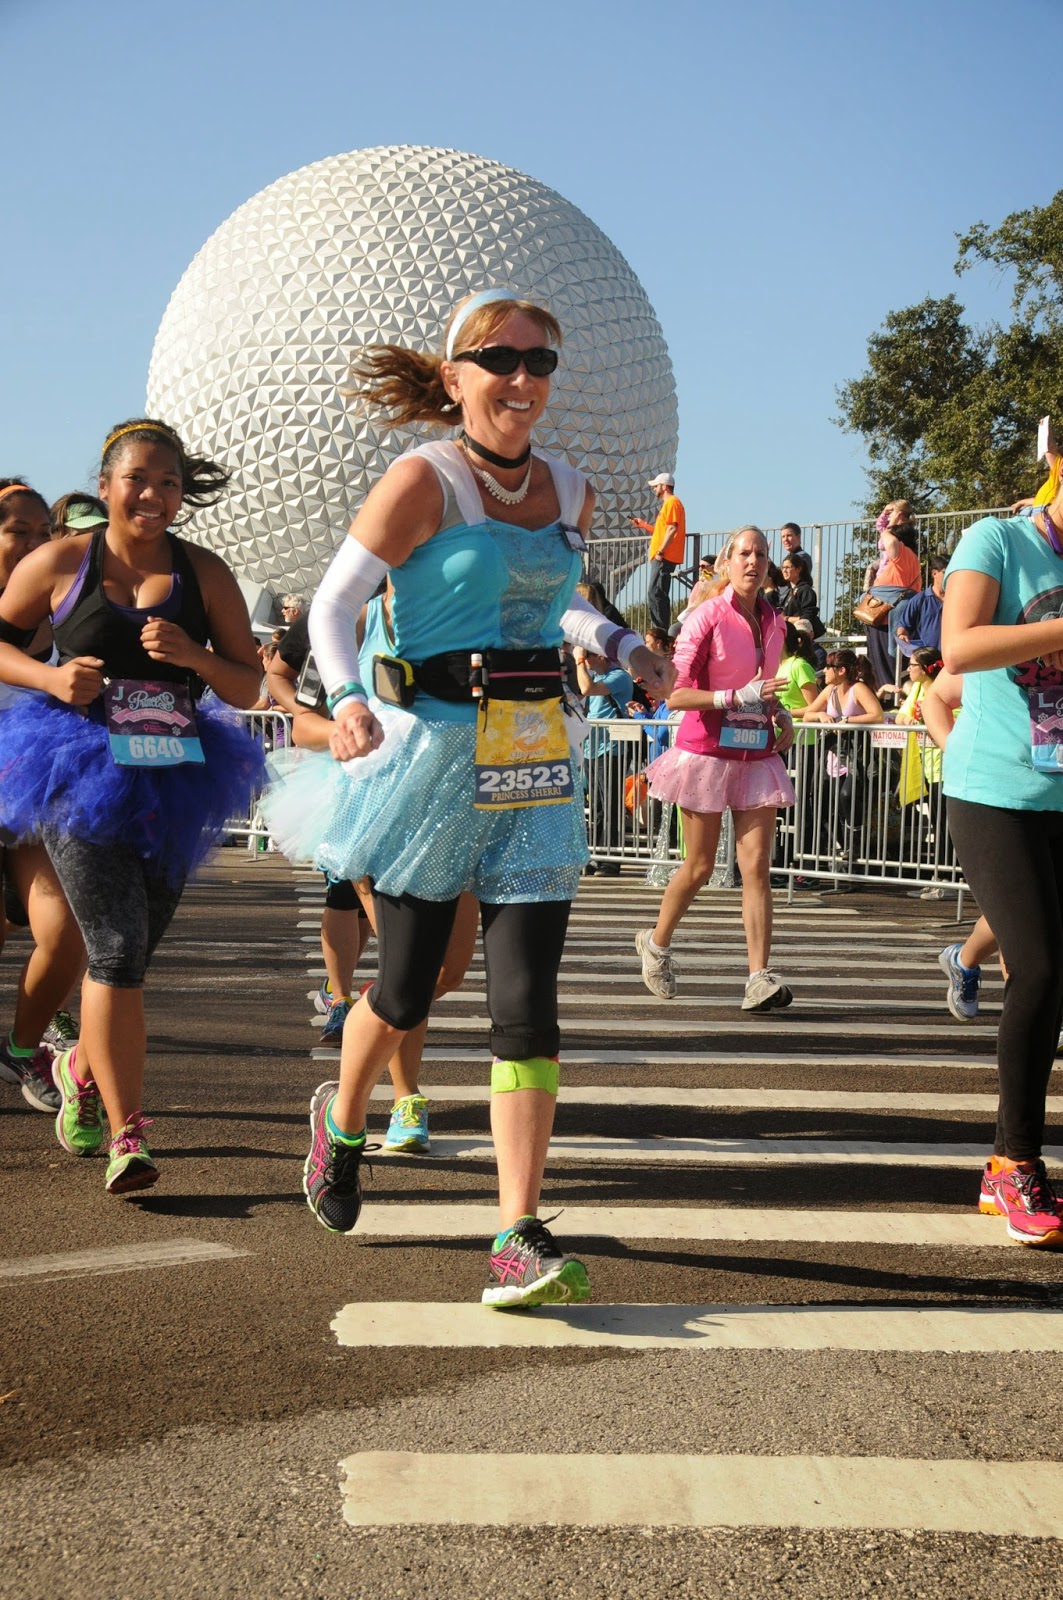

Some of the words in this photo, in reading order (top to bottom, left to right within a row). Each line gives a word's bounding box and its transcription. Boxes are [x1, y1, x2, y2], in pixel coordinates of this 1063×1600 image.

[112, 686, 124, 700] J
[1038, 692, 1054, 708] L
[141, 710, 172, 721] MARATHON
[733, 728, 760, 744] 3061
[872, 731, 907, 740] NATIONAL
[129, 736, 185, 759] 6640
[479, 764, 570, 792] 23523
[491, 790, 529, 801] PRINCESS
[530, 786, 562, 798] SHERRI
